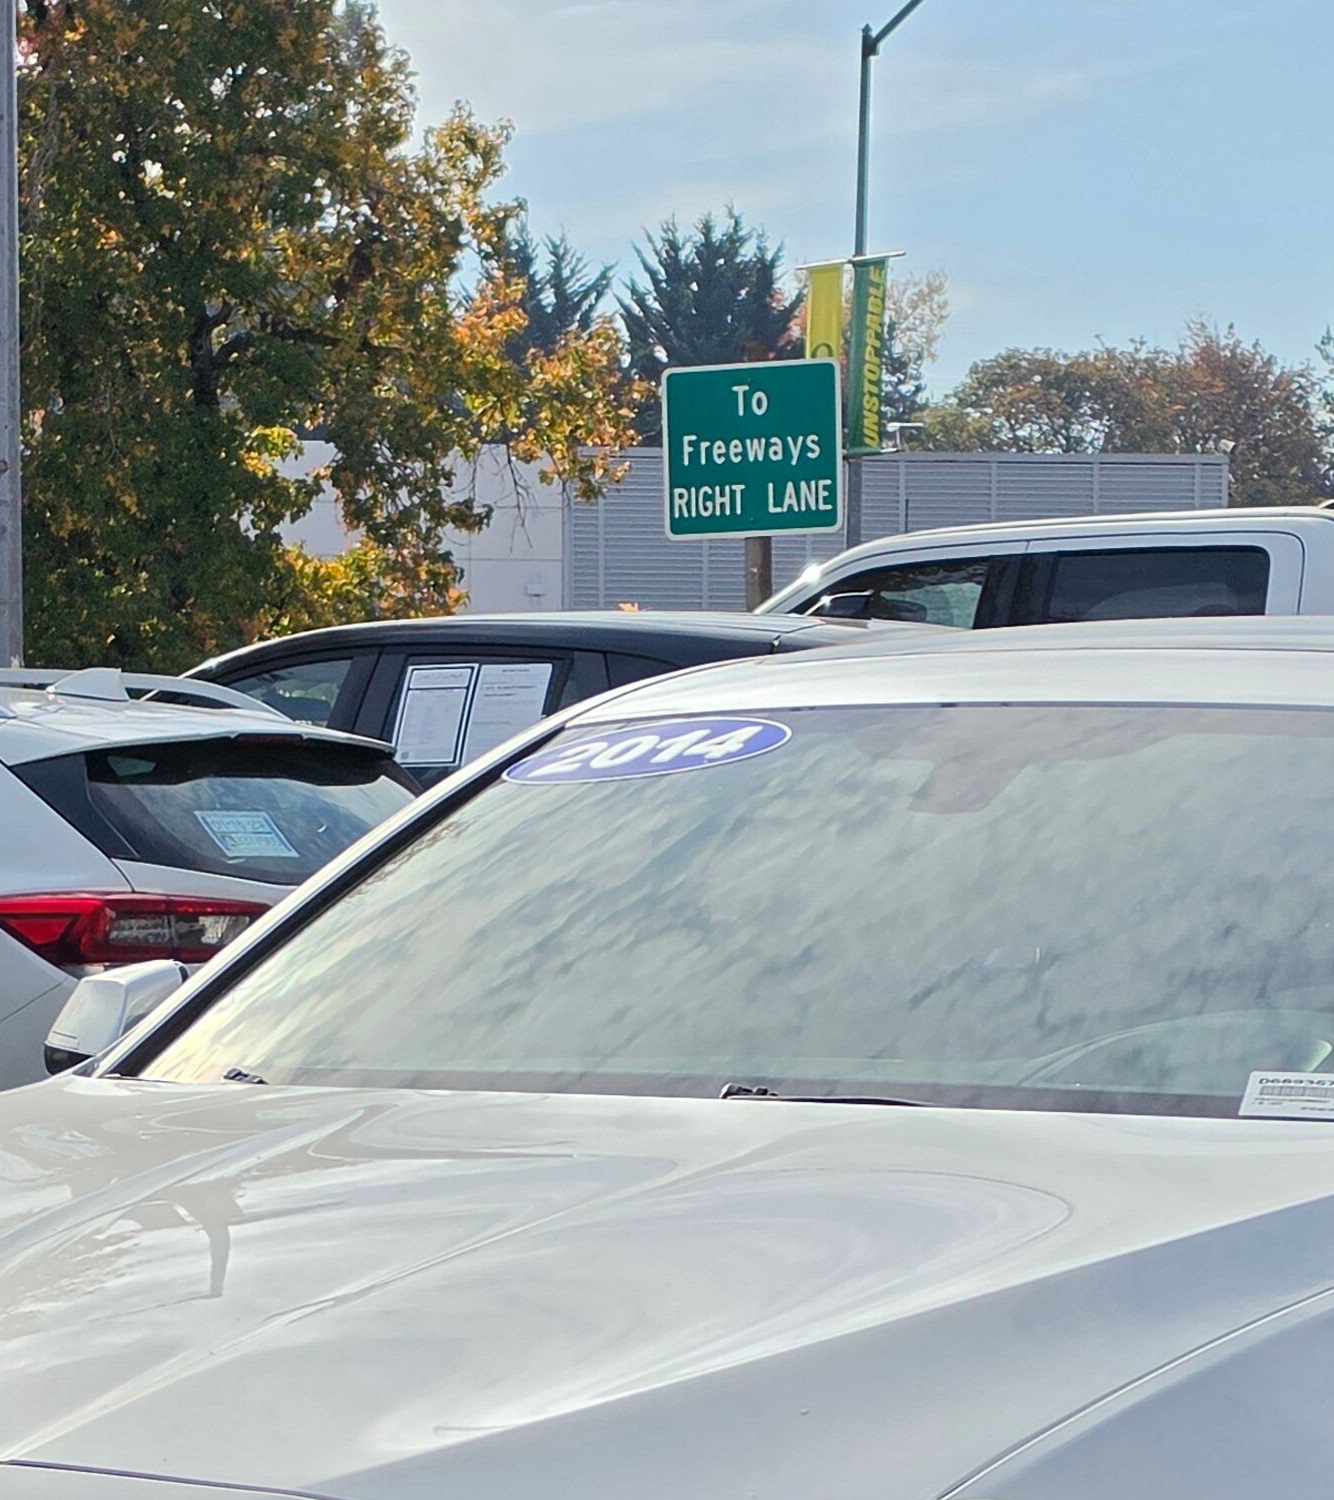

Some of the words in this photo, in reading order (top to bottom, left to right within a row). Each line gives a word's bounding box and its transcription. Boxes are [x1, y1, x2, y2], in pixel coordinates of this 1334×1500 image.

[862, 265, 886, 448] UNSTOPPABLE
[731, 384, 768, 417] To
[681, 433, 821, 466] Freeways
[673, 483, 746, 519] RIGHT
[768, 478, 833, 514] LANE
[526, 725, 765, 778] 2014
